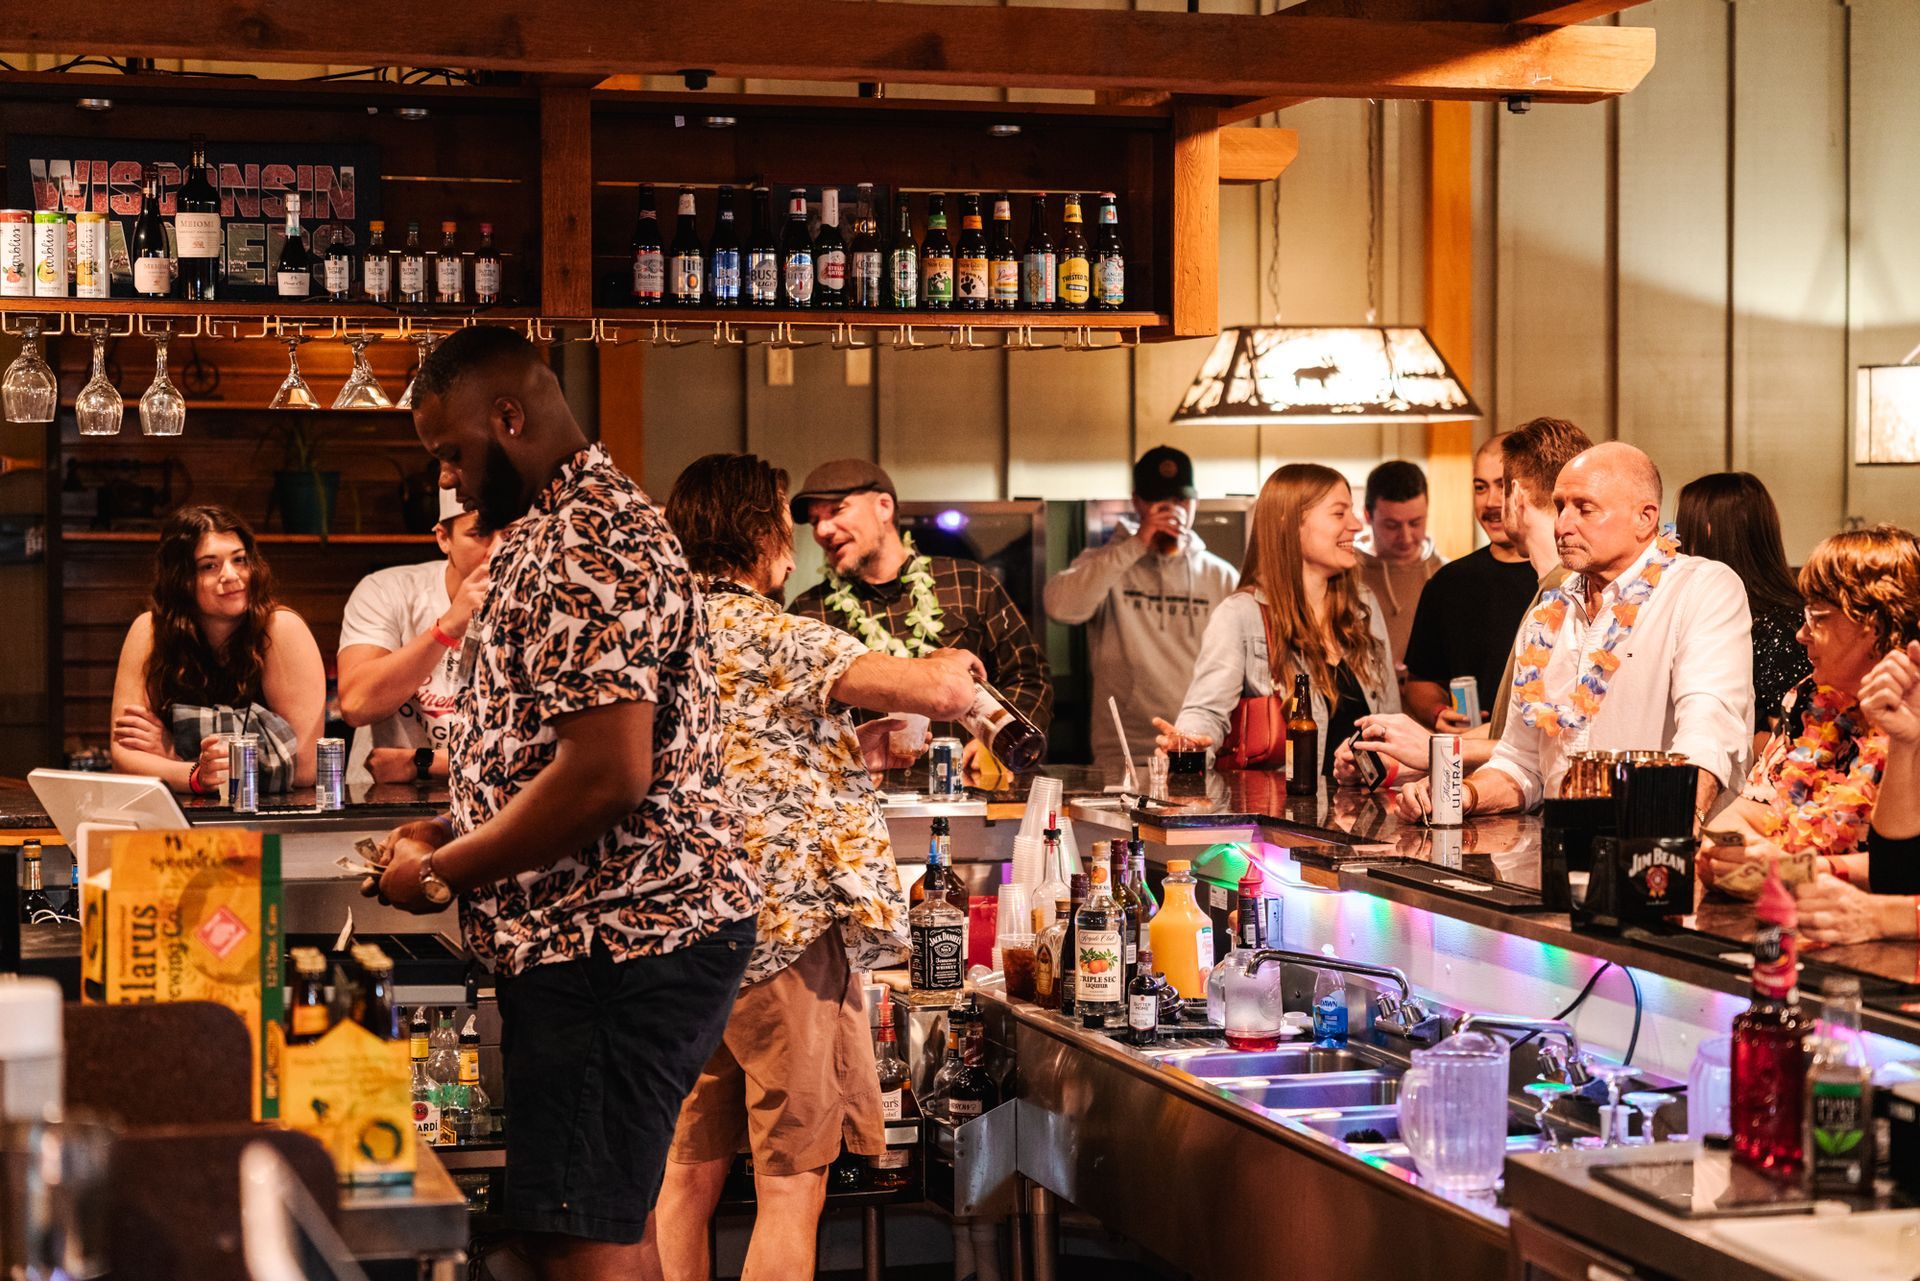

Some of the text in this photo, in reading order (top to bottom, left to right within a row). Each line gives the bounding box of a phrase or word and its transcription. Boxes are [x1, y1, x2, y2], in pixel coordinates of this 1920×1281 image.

[180, 220, 214, 228] MEIOMI
[1452, 759, 1461, 809] ULTRA
[1628, 847, 1686, 877] JIM BEAM
[929, 932, 962, 947] JACK DANIEL'S
[1321, 999, 1338, 1008] DAWN
[415, 1119, 438, 1132] ARDÍ
